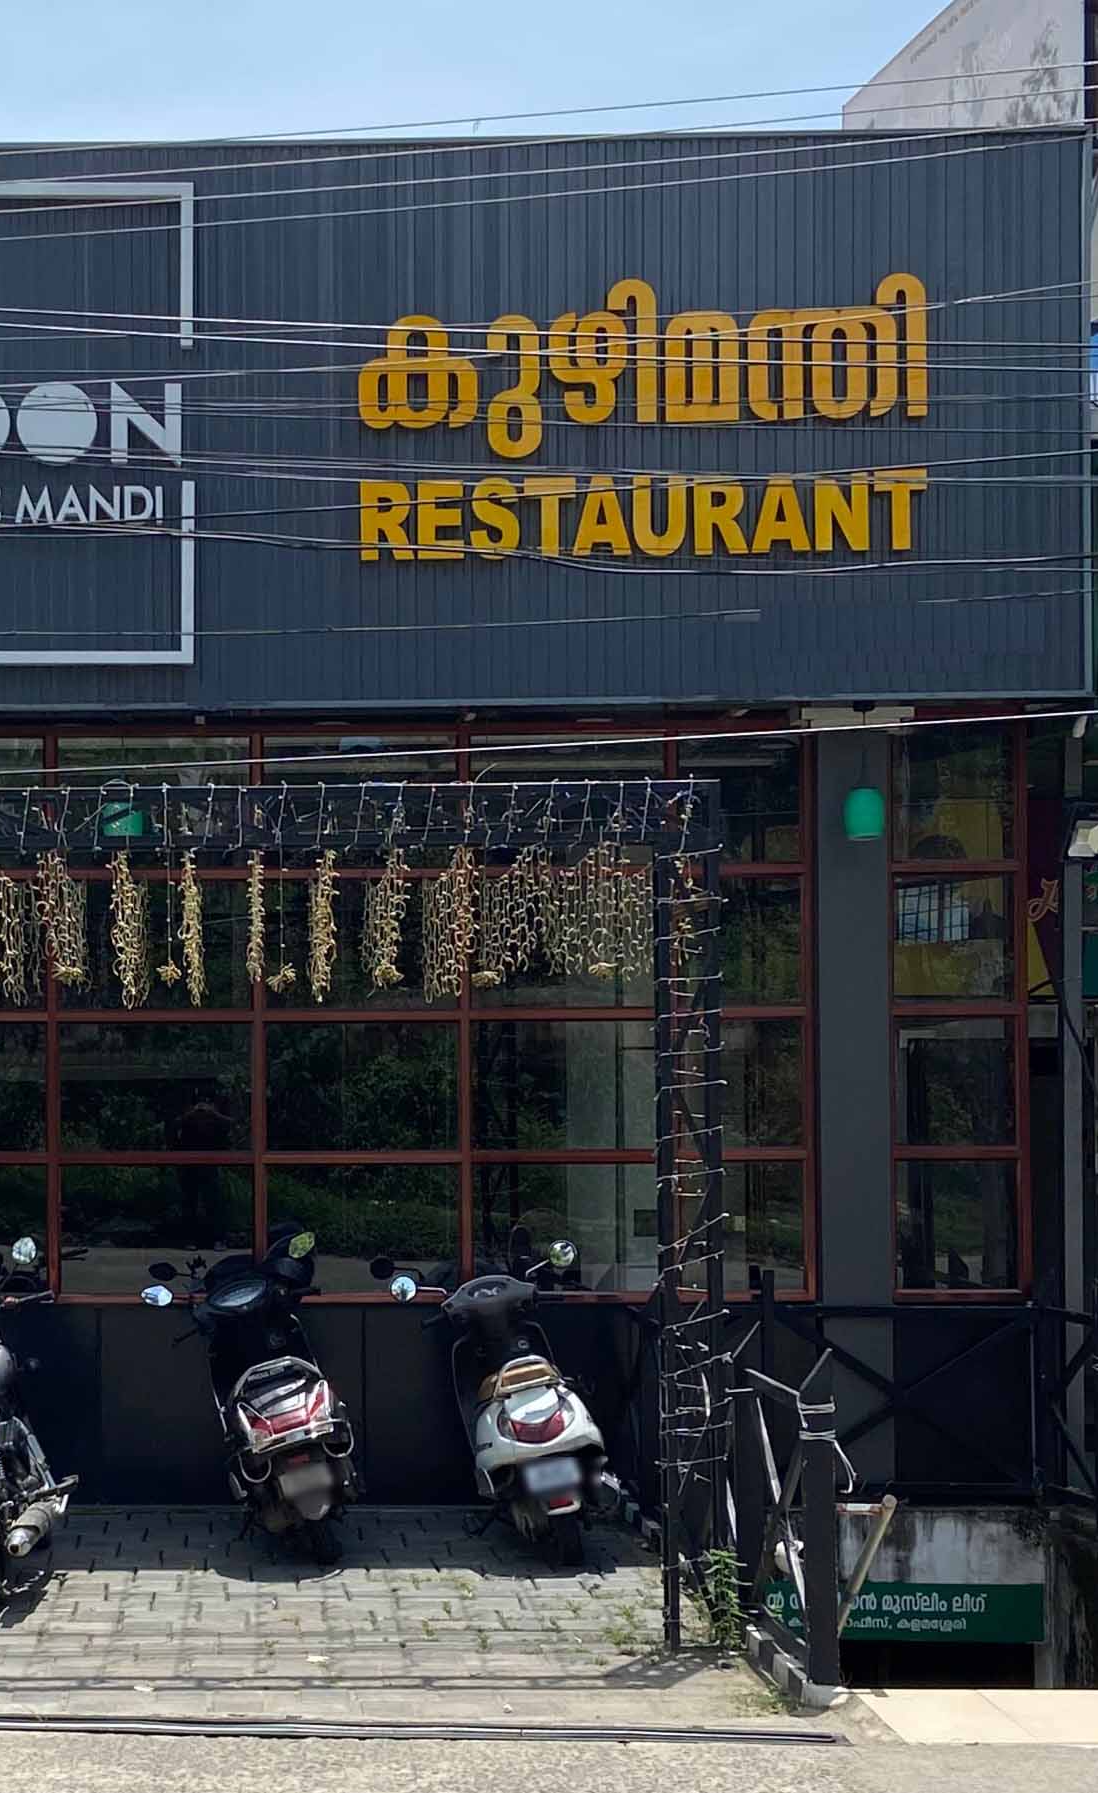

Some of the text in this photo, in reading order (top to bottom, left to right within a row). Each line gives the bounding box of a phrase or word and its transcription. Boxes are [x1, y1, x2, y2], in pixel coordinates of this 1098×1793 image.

[357, 272, 929, 459] കുഴിമന്തി
[15, 484, 164, 525] MANDI
[360, 468, 928, 562] RESTAURANT
